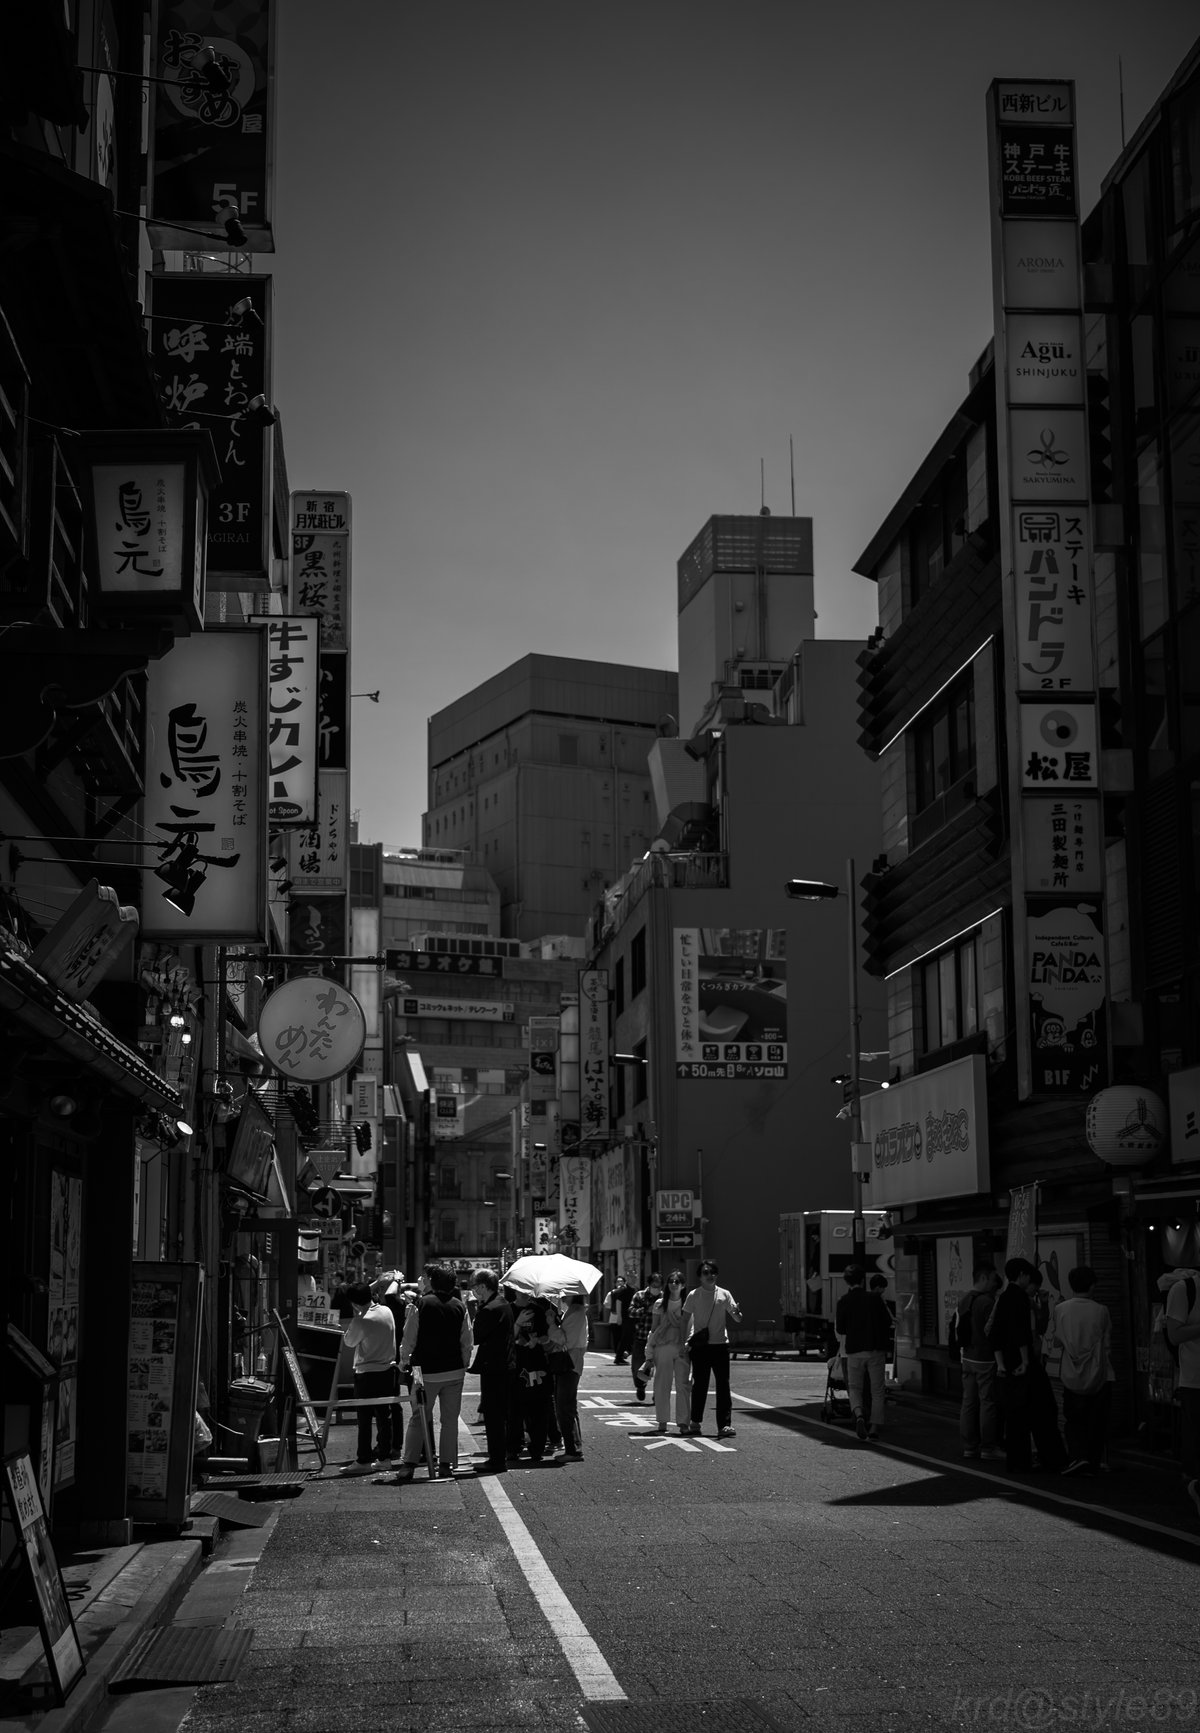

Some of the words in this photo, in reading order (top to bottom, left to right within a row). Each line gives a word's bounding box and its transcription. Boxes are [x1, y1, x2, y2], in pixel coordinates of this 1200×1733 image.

[1002, 94, 1068, 113] 西新ビル
[1003, 142, 1070, 160] 神戸牛
[1005, 160, 1070, 176] ステーキ
[1047, 175, 1071, 183] STEAK
[211, 183, 259, 215] 5F
[1017, 257, 1065, 268] AROMA
[163, 324, 210, 429] 呼炉
[1016, 368, 1078, 378] SHINJUKU
[219, 502, 251, 522] 3F
[306, 500, 335, 512] 新宿
[113, 481, 164, 577] 鳥元
[207, 532, 250, 543] AGIRAI
[294, 536, 310, 549] 3F
[1064, 517, 1086, 605] ステーキ
[298, 550, 328, 608] 黒桜
[1021, 548, 1065, 674] パンドラ
[1041, 678, 1071, 688] 2F
[231, 700, 248, 827] 炭火串焼・十割そば
[1026, 752, 1091, 781] 松屋
[278, 806, 299, 817] Spoon
[1051, 803, 1069, 888] 三田製麺所
[1073, 804, 1084, 872] つけ麺専門店
[1032, 951, 1101, 968] PANDA
[1031, 967, 1090, 984] LINDA
[275, 1025, 308, 1069] めん
[1044, 1069, 1071, 1085] B1F
[661, 1193, 690, 1209] NPC
[665, 1213, 687, 1223] 24H
